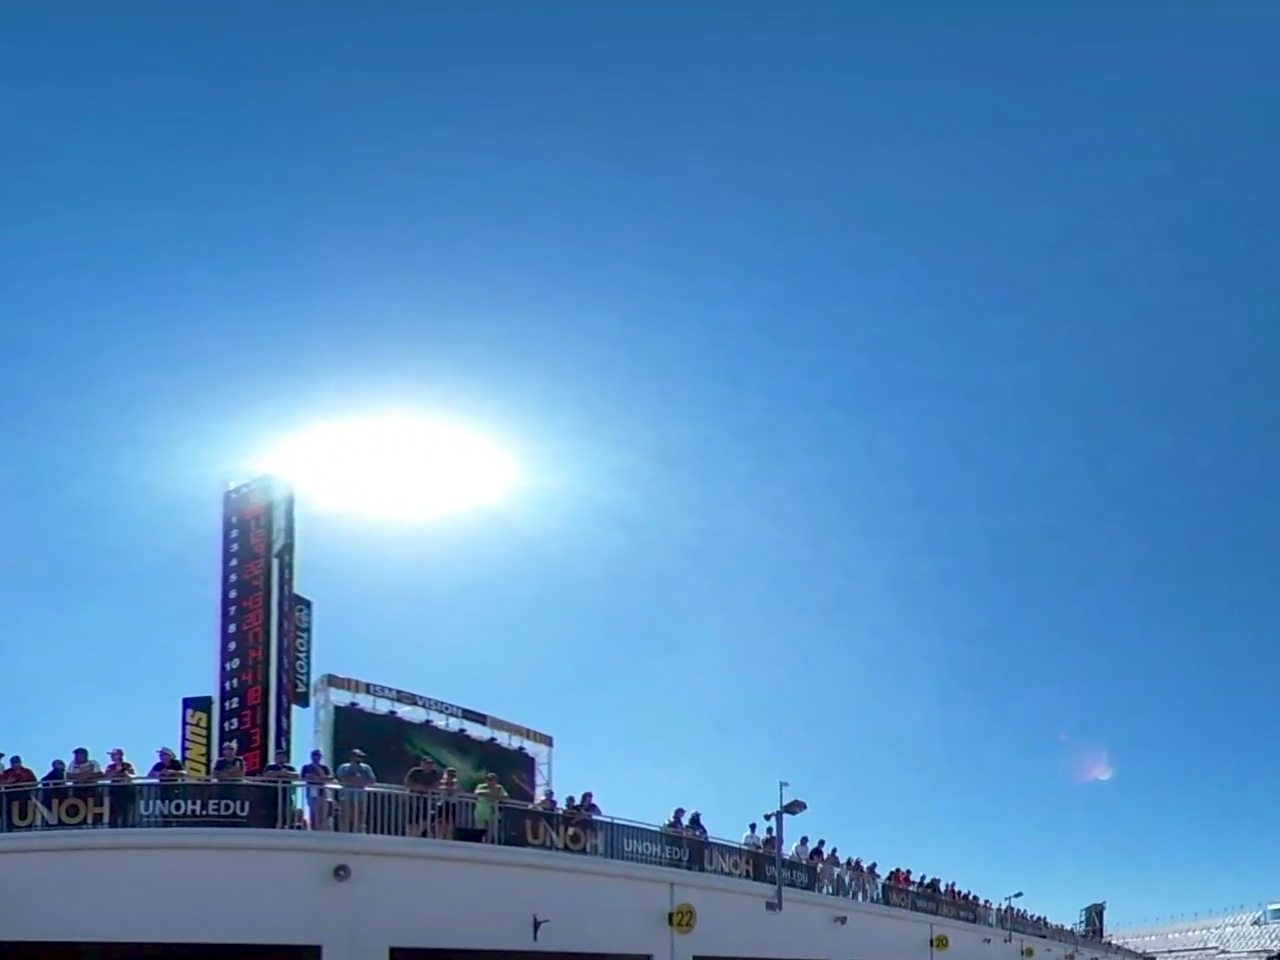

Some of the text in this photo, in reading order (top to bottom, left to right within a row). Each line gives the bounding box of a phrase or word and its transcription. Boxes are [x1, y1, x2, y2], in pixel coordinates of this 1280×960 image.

[224, 657, 240, 672] 10
[295, 631, 308, 693] TOYOTA
[224, 677, 238, 692] 11
[223, 697, 240, 711] 12
[369, 683, 463, 718] ISM VISION
[223, 717, 239, 732] 13
[10, 795, 111, 828] UNOH
[139, 798, 251, 817] UNOH.EDU
[525, 818, 605, 853] UNOH
[623, 837, 690, 862] UNOH.EDU
[675, 910, 694, 928] 22
[934, 935, 948, 948] 20
